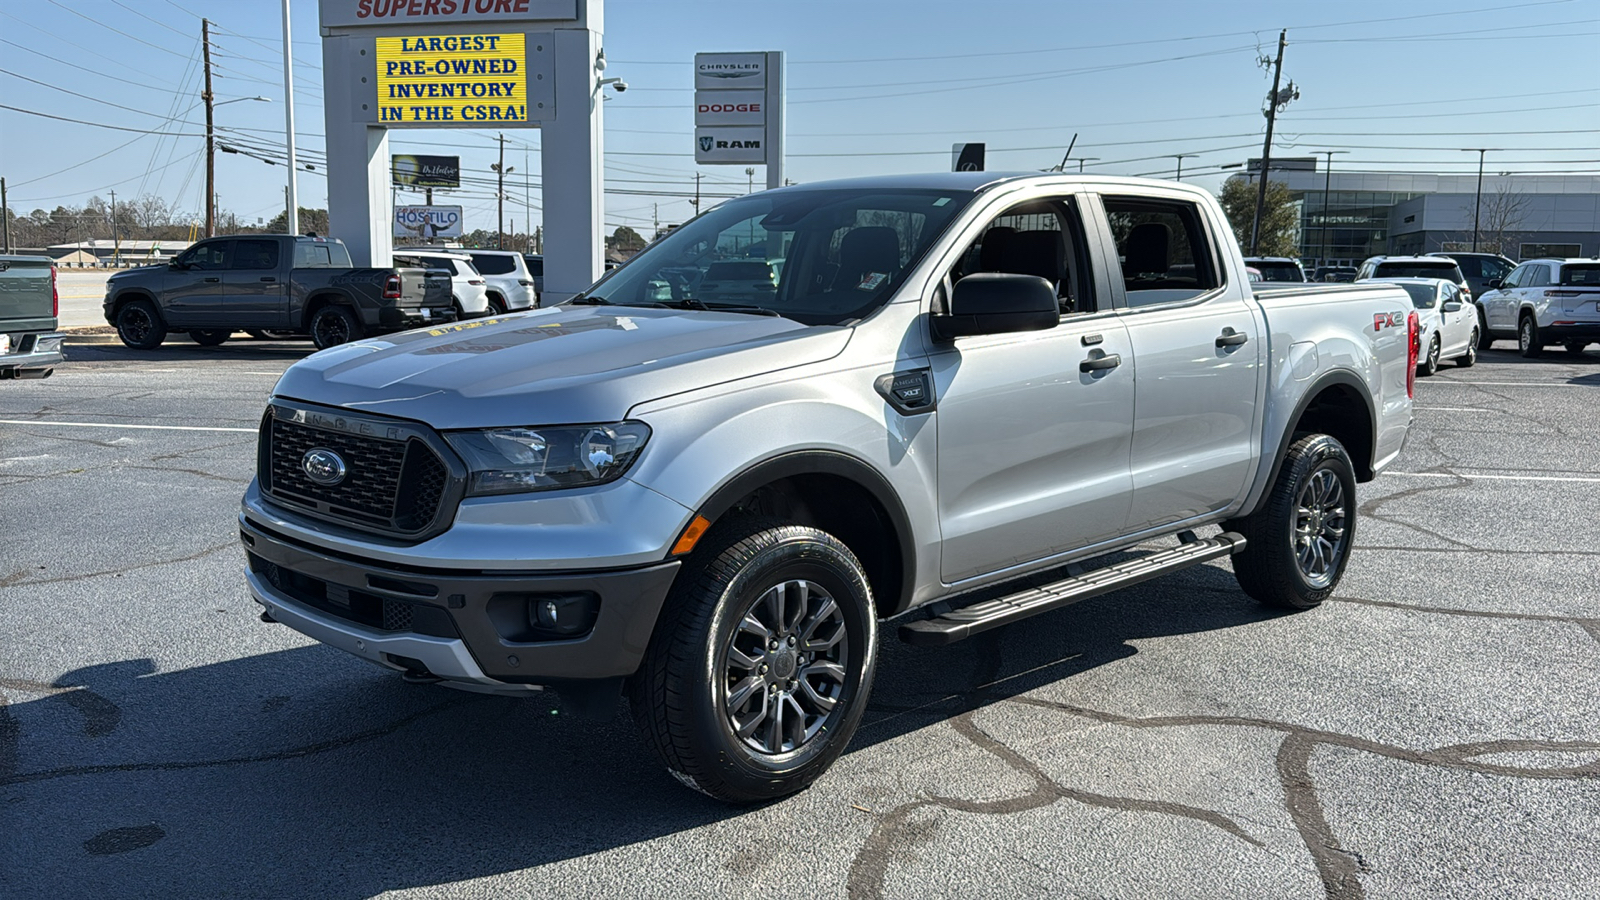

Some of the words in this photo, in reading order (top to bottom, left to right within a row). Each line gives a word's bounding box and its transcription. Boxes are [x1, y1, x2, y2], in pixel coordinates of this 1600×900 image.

[356, 0, 530, 18] SUPERSTORE
[401, 36, 500, 52] LARGEST
[386, 59, 517, 75] PRE-OWNED
[389, 82, 516, 98] INVENTORY
[381, 106, 403, 121] IN
[410, 106, 453, 120] THE
[461, 105, 526, 120] CSRA!
[698, 104, 760, 113] DODGE
[716, 141, 760, 149] RAM
[396, 211, 458, 223] HOSTILO
[1373, 311, 1404, 331] FX2
[903, 388, 920, 397] XLT
[276, 407, 401, 439] ANGER
[306, 453, 333, 477] Ford
